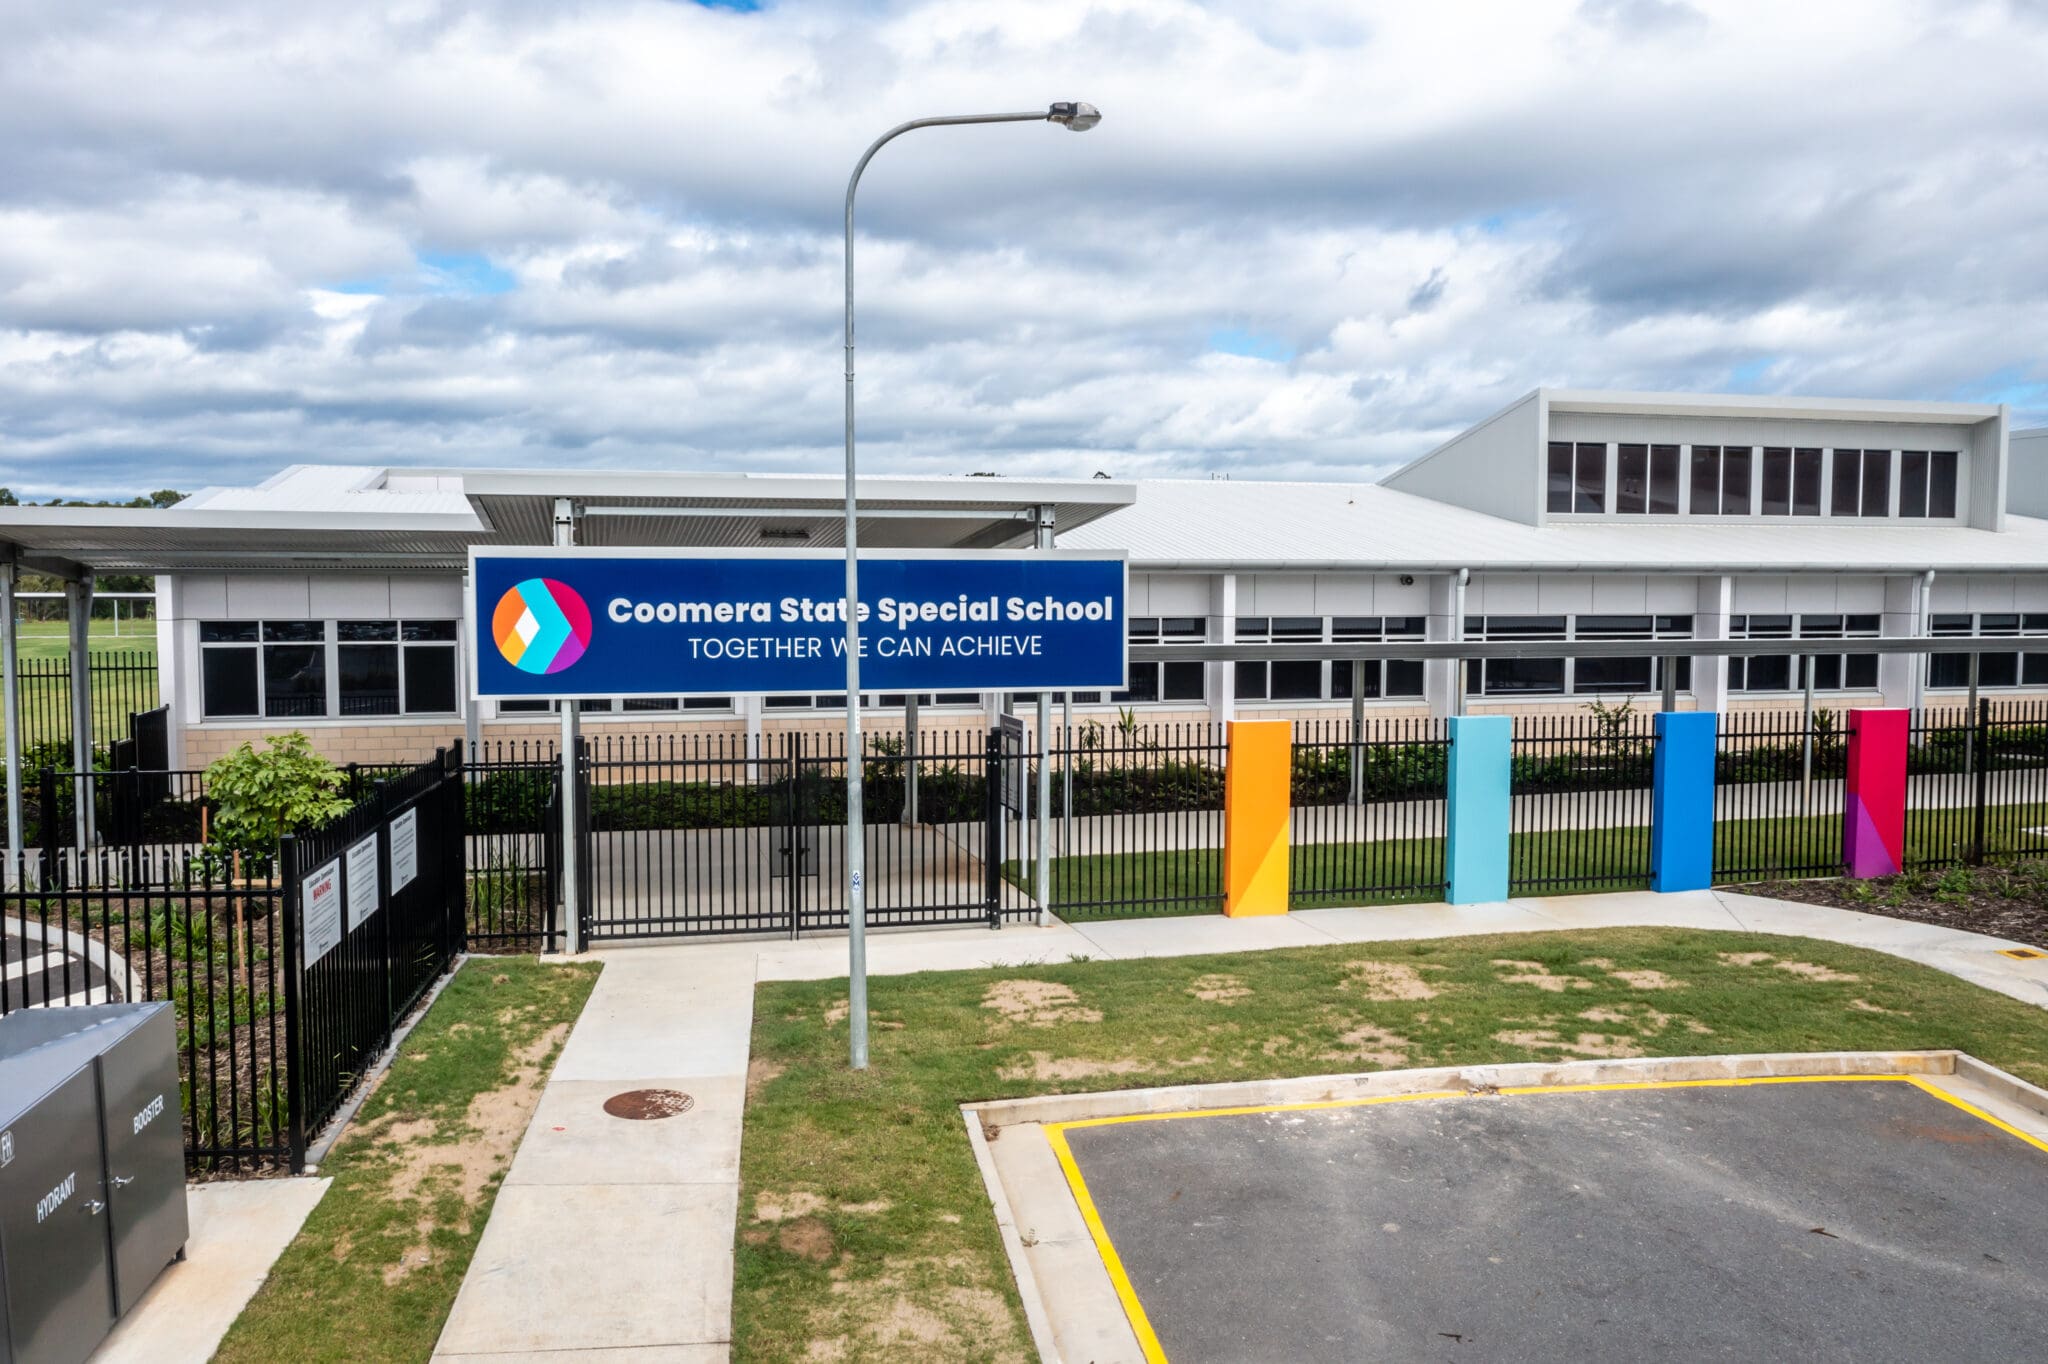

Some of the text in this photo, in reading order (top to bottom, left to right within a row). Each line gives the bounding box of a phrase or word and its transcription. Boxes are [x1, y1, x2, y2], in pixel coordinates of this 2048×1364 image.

[608, 594, 1113, 630] Coomera State Special School
[688, 635, 1043, 659] TOGETHER WE CAN ACHIEVE
[133, 1094, 164, 1135] BOOSTER
[36, 1171, 76, 1224] HYDRANT
